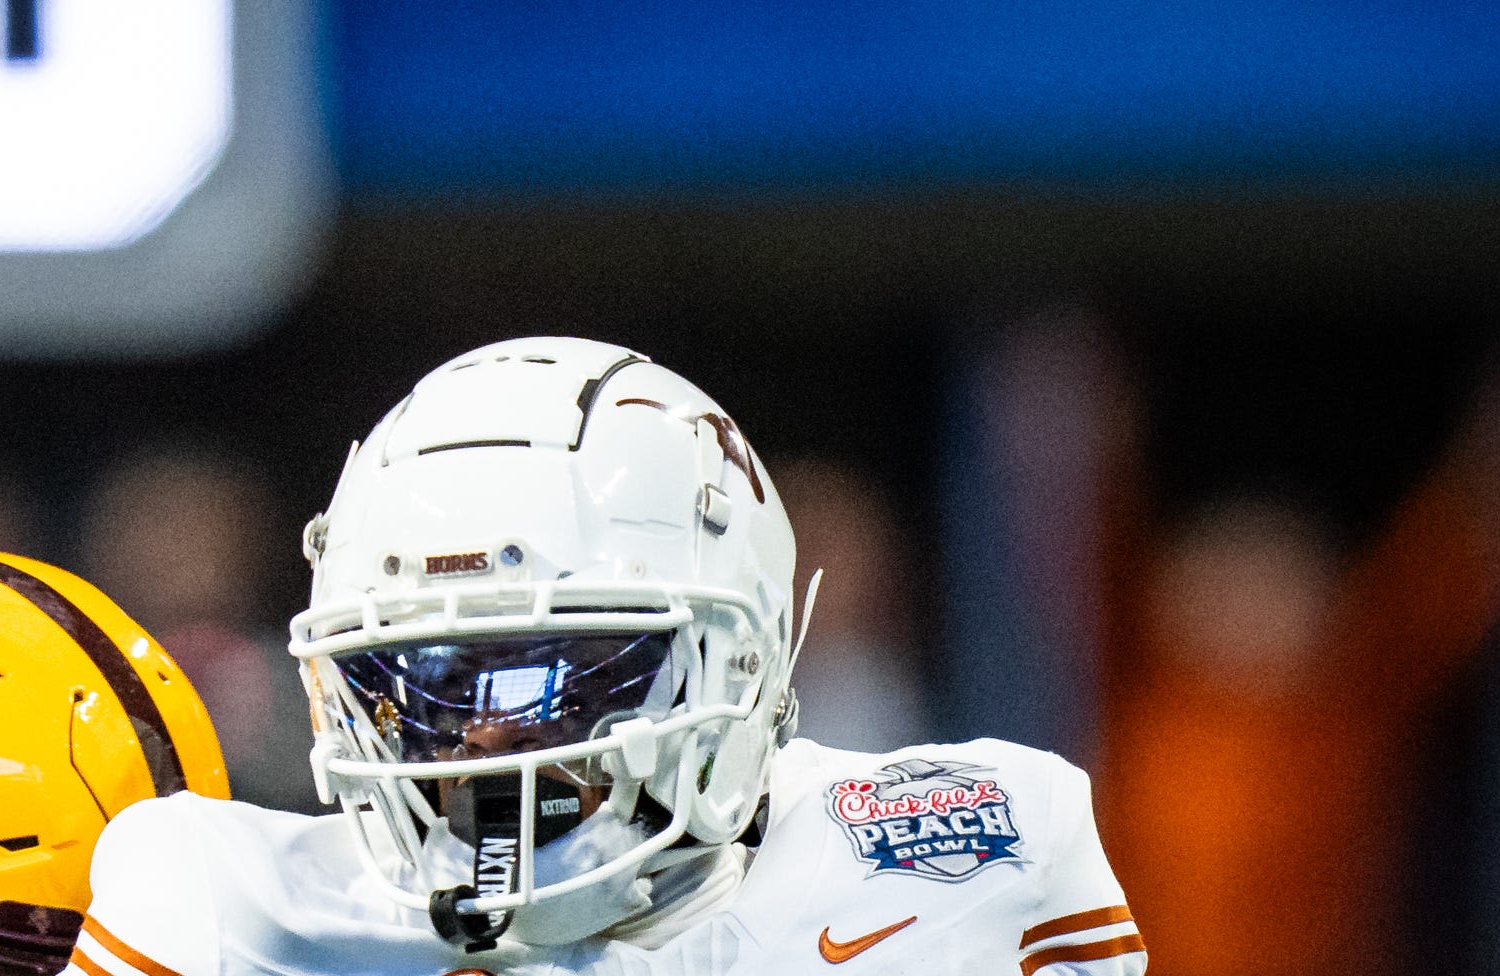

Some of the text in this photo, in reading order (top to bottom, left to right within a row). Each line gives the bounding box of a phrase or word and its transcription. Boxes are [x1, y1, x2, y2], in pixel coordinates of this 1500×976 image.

[837, 781, 1004, 822] Chick-fil-A
[854, 805, 1017, 854] PEACH
[893, 838, 990, 860] BOWL
